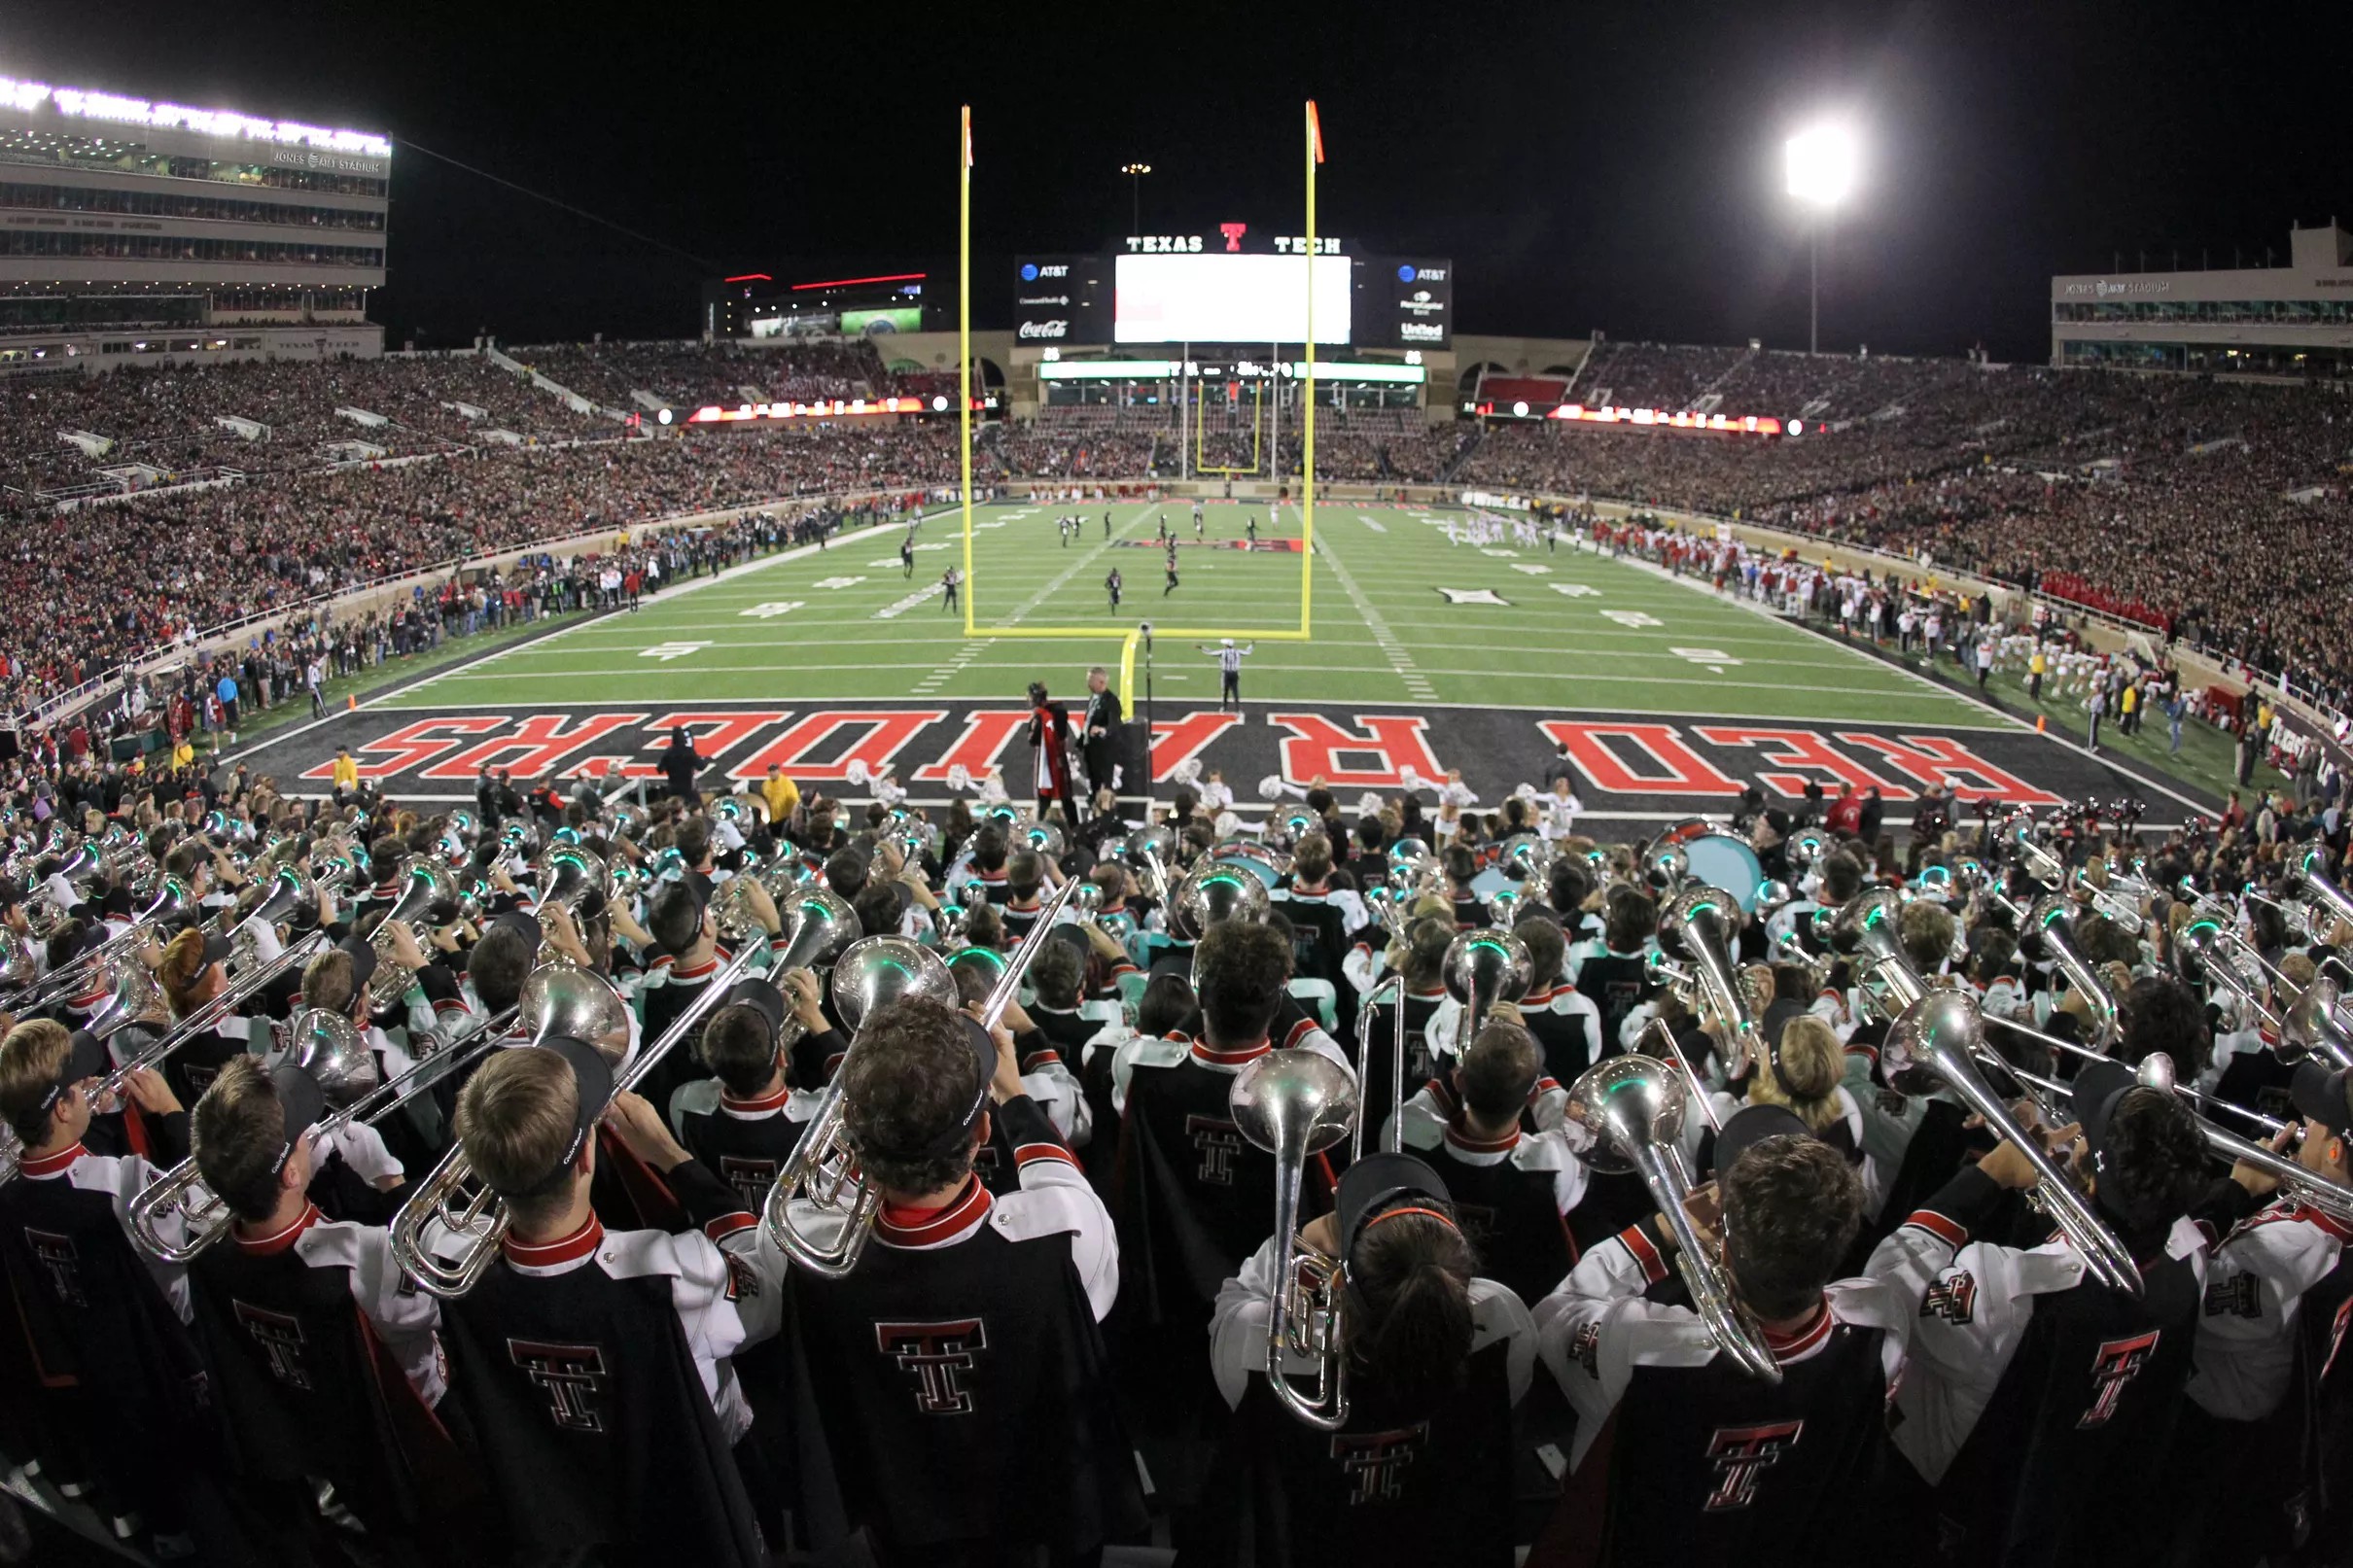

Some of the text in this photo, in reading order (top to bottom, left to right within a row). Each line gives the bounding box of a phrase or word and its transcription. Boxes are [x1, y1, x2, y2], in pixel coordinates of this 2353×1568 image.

[274, 151, 305, 165] JONES
[338, 158, 380, 174] STADIUM
[1126, 235, 1342, 255] TEXAS TECH
[1039, 265, 1070, 278] AT&T
[1417, 268, 1447, 281] AT&T
[1536, 719, 2073, 805] RED
